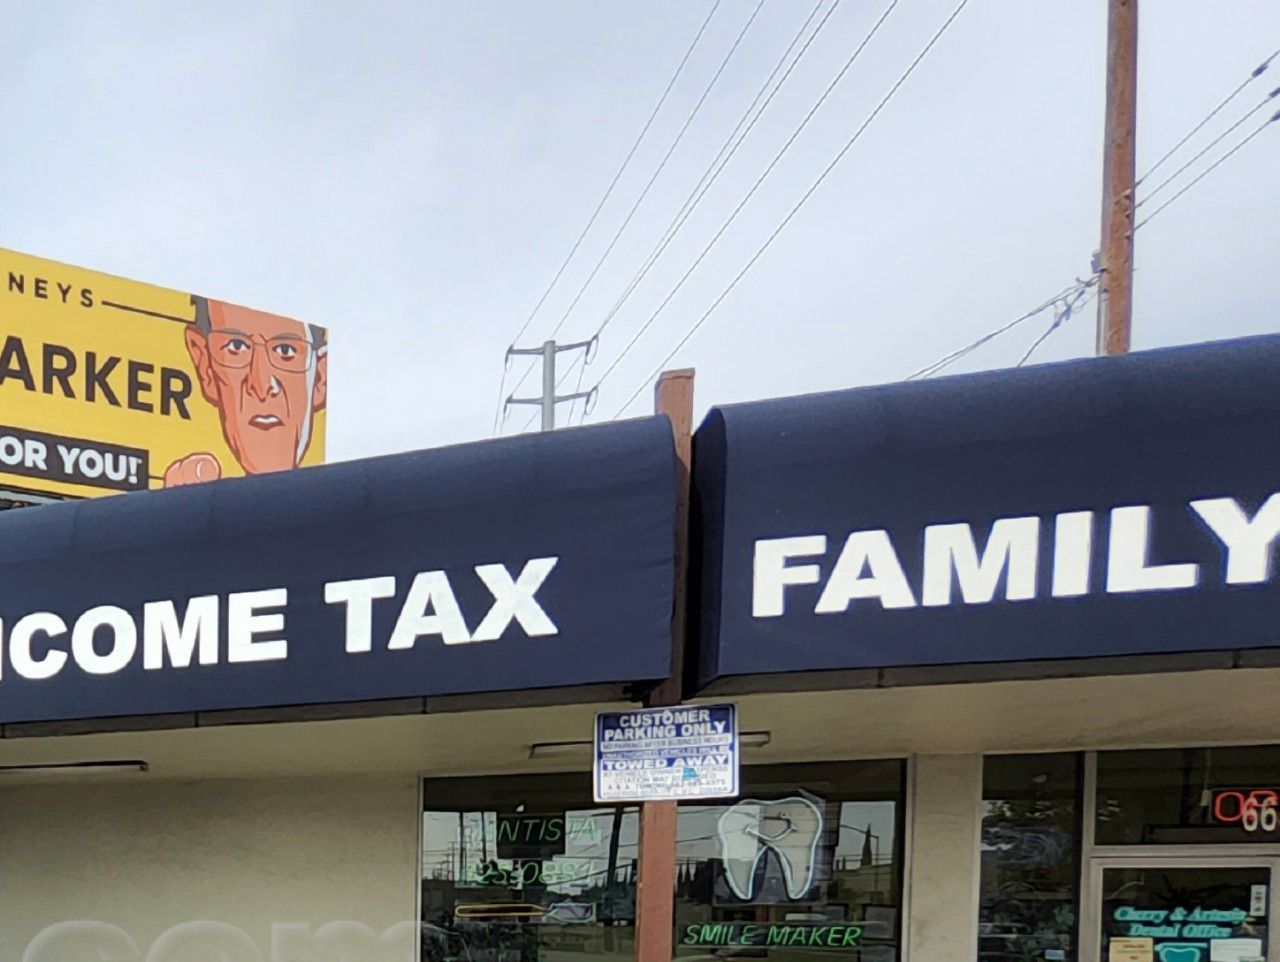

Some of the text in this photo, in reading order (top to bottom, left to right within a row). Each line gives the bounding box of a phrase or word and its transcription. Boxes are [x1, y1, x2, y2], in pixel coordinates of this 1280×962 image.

[57, 444, 140, 484] YOU!
[752, 491, 1280, 617] FAMILY
[324, 556, 559, 654] TAX
[619, 709, 711, 728] CUSTOMER
[604, 721, 726, 741] PARKING ONLY
[605, 755, 727, 771] TOWED AWAY
[683, 924, 862, 946] SMILE MAKER
[1128, 923, 1181, 937] Dental
